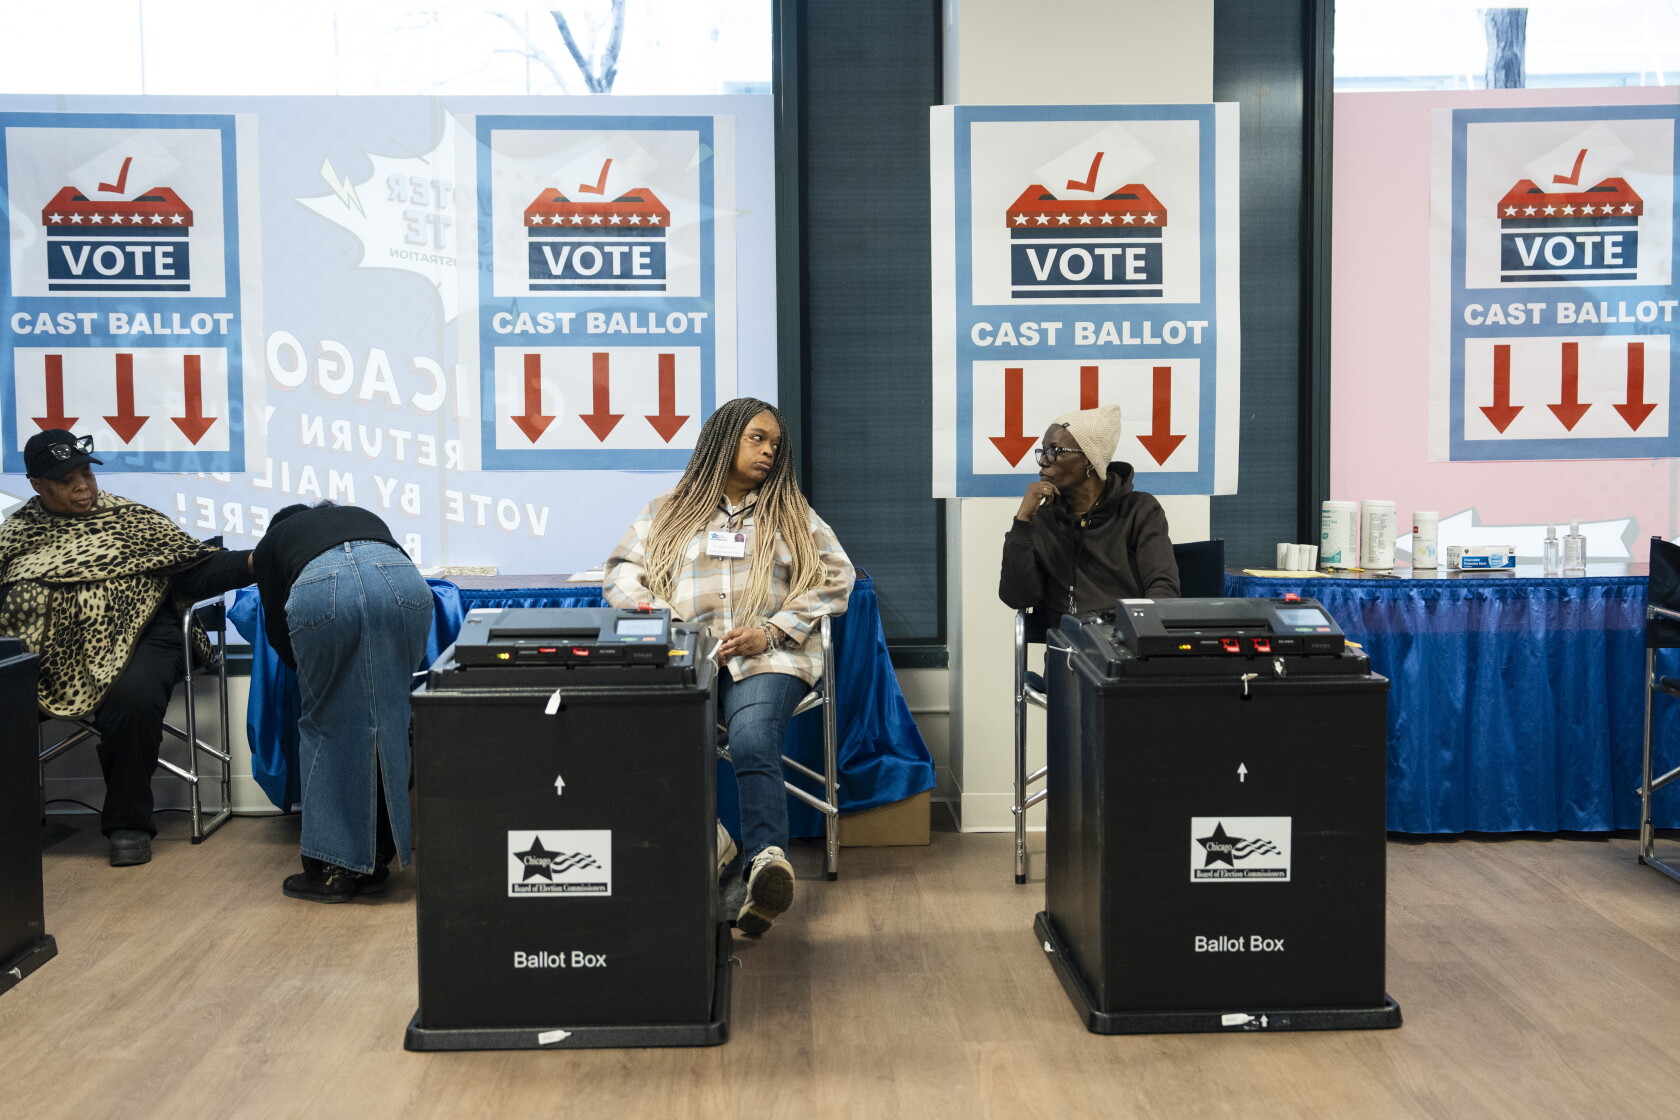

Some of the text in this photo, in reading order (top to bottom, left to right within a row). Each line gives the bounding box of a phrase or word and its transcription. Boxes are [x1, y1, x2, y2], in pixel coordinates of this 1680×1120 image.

[61, 245, 176, 276] VOTE
[541, 245, 652, 276] VOTE
[1514, 235, 1624, 267] VOTE
[1026, 247, 1147, 281] VOTE
[10, 312, 234, 335] CAST BALLOT
[492, 311, 708, 334] CAST BALLOT
[1463, 300, 1679, 326] CAST BALLOT
[970, 320, 1209, 347] CAST BALLOT
[1206, 841, 1233, 853] Chicago
[523, 855, 551, 868] Chicago
[1196, 868, 1285, 878] Board of Election Commissioners
[514, 883, 606, 892] Board of Election Commissioners
[1195, 935, 1285, 952] Ballot Box
[514, 950, 607, 968] Ballot Box
